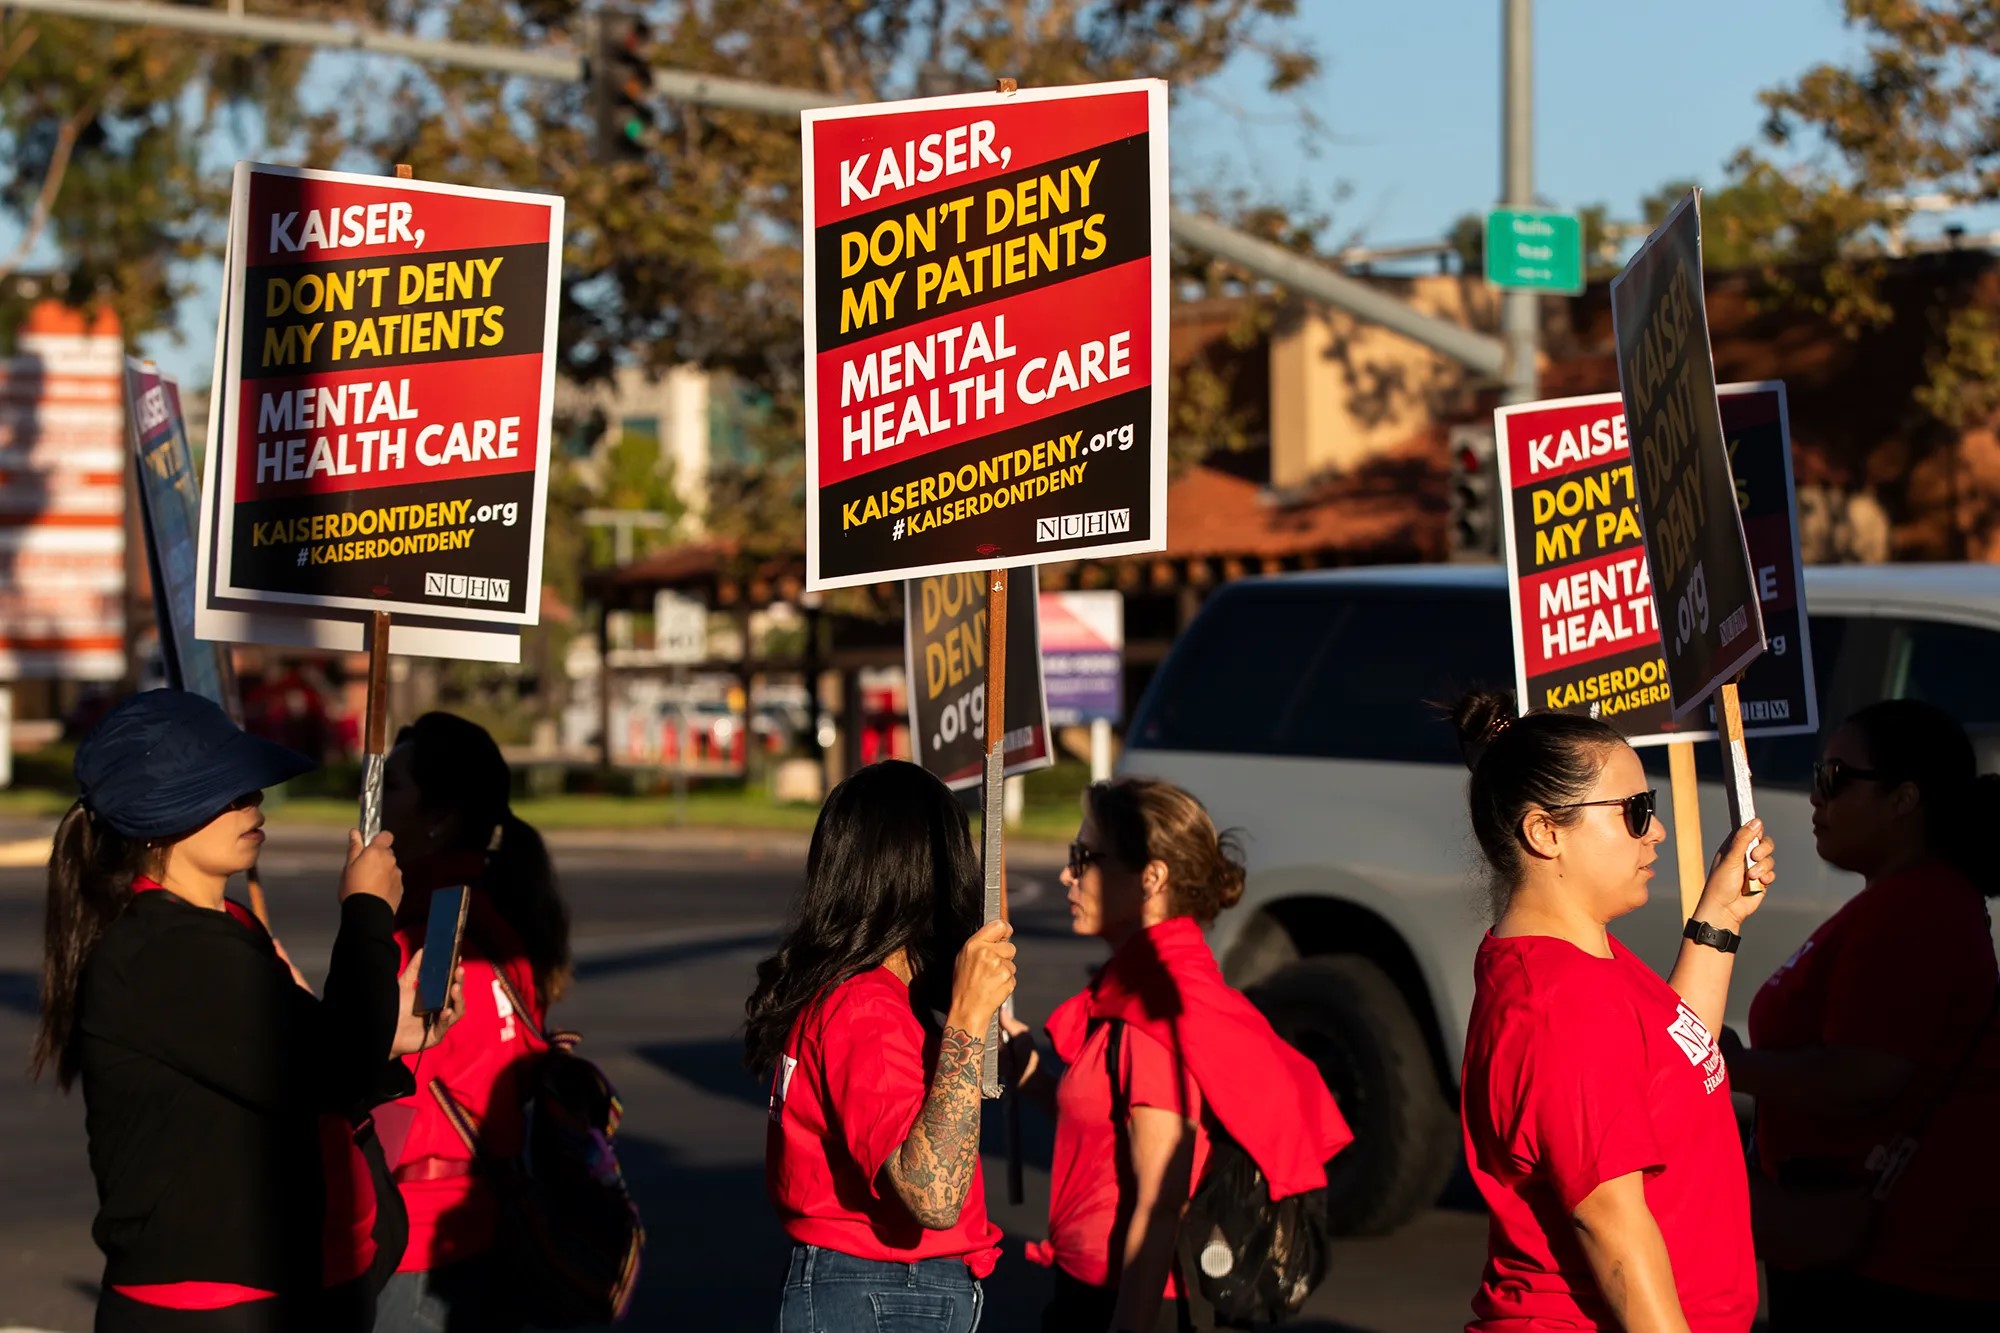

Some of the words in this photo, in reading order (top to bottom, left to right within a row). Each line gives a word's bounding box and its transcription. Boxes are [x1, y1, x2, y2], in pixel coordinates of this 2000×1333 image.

[840, 119, 1013, 208] KAISER,
[269, 201, 426, 254] KAISER,
[840, 195, 974, 280] DON'T
[985, 158, 1102, 237] DENY
[265, 266, 391, 318] DON'T
[398, 256, 504, 306] DENY
[839, 270, 908, 335] MY
[916, 213, 1108, 311] PATIENTS
[261, 320, 323, 368] MY
[331, 305, 505, 361] PATIENTS
[840, 314, 1016, 409] MENTAL
[1629, 257, 1693, 428] KAISER
[257, 378, 419, 435] MENTAL
[841, 369, 1005, 462] HEALTH
[1016, 330, 1132, 407] CARE
[256, 428, 406, 484] HEALTH
[415, 416, 521, 468] CARE
[1528, 414, 1629, 475] KAISE
[1642, 358, 1696, 511] DONT
[842, 422, 1135, 531] KAISERDONTDENY.org
[892, 460, 1088, 542] #KAISERDONTDENY
[1532, 465, 1635, 526] DON'T
[252, 498, 519, 548] KAISERDONTDENY.org
[296, 528, 475, 567] #KAISERDONTDENY
[1036, 507, 1131, 543] NUHW
[1535, 518, 1588, 566] MY
[1656, 447, 1705, 592] DENY
[425, 572, 510, 603] NUHW
[921, 572, 986, 635] DON
[1539, 556, 1652, 620] MENTA
[1675, 559, 1709, 657] .org
[925, 607, 986, 700] DEN
[1589, 682, 1671, 720] #KAISERD
